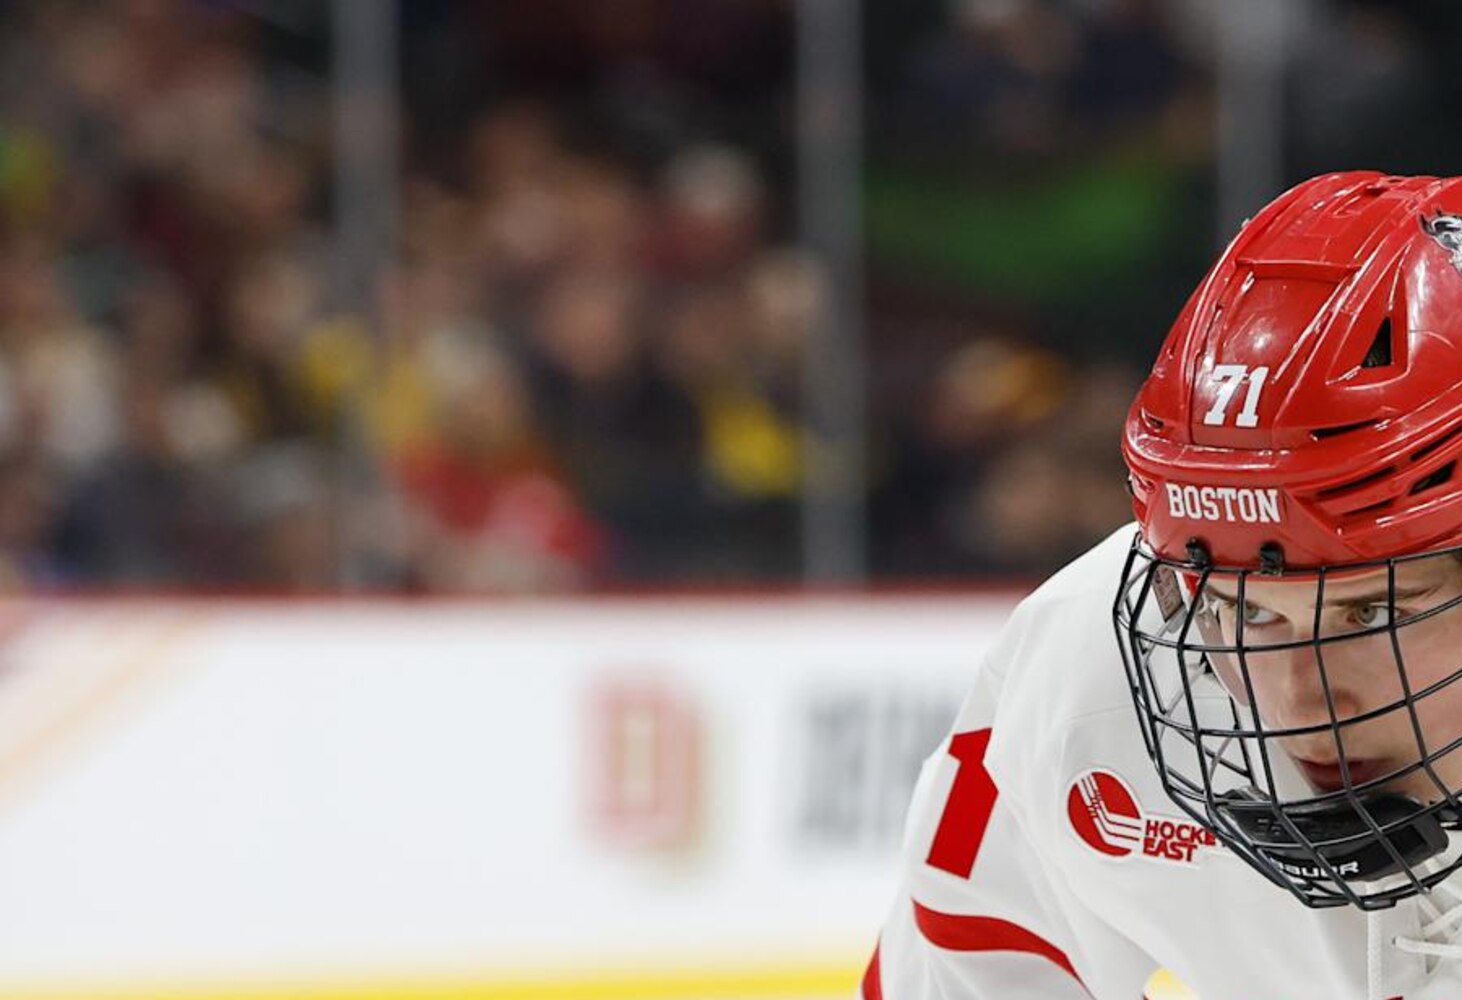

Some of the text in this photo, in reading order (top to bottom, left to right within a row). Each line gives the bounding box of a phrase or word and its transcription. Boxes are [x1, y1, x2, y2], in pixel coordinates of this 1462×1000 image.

[1203, 364, 1270, 428] 71
[1165, 482, 1281, 523] BOSTON
[1143, 837, 1198, 862] EAST
[1145, 819, 1217, 847] HOCKE
